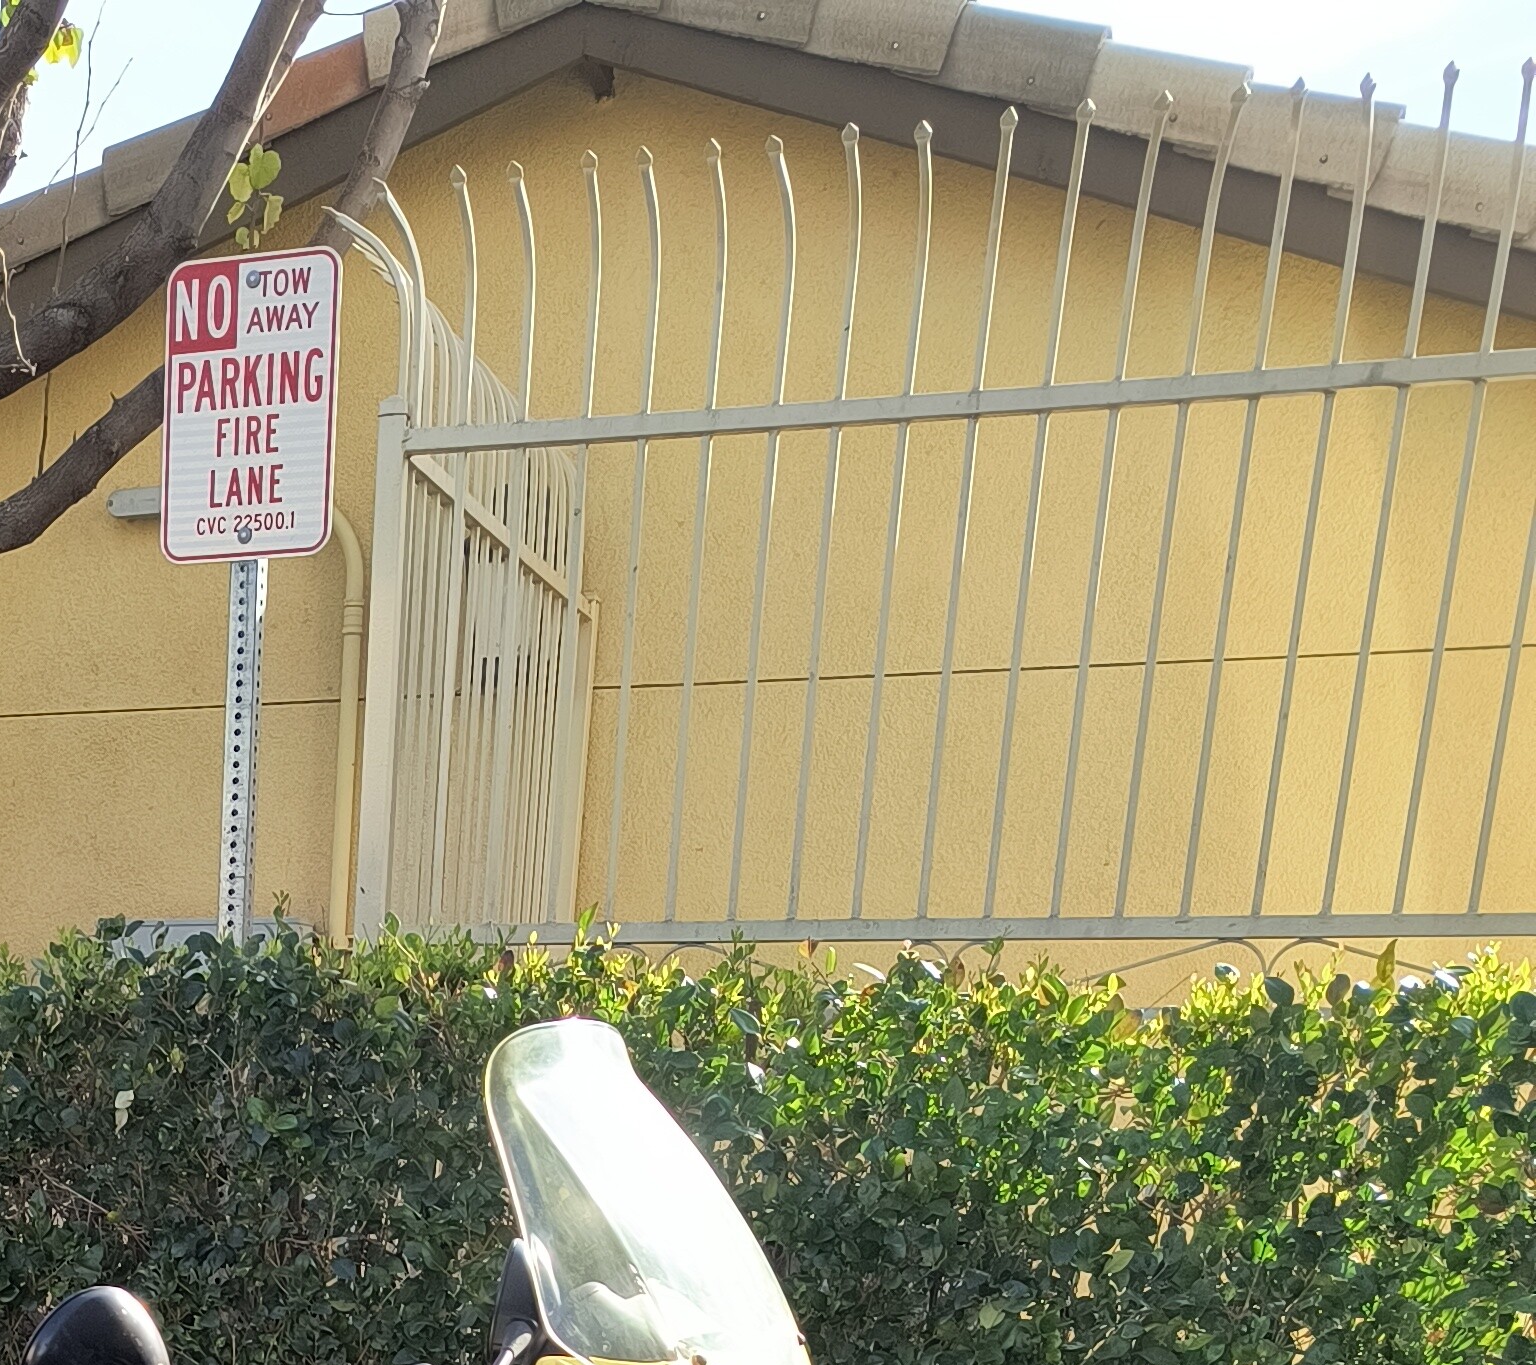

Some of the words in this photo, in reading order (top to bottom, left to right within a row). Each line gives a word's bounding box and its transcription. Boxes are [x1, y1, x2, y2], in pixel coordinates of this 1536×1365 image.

[257, 267, 312, 298] TOW
[174, 274, 233, 343] NO
[246, 301, 321, 335] AWAY
[176, 348, 325, 414] PARKING
[215, 413, 280, 458] FIRE
[208, 464, 284, 509] LANE
[196, 516, 227, 536] CVC
[233, 511, 296, 534] 22500.1
